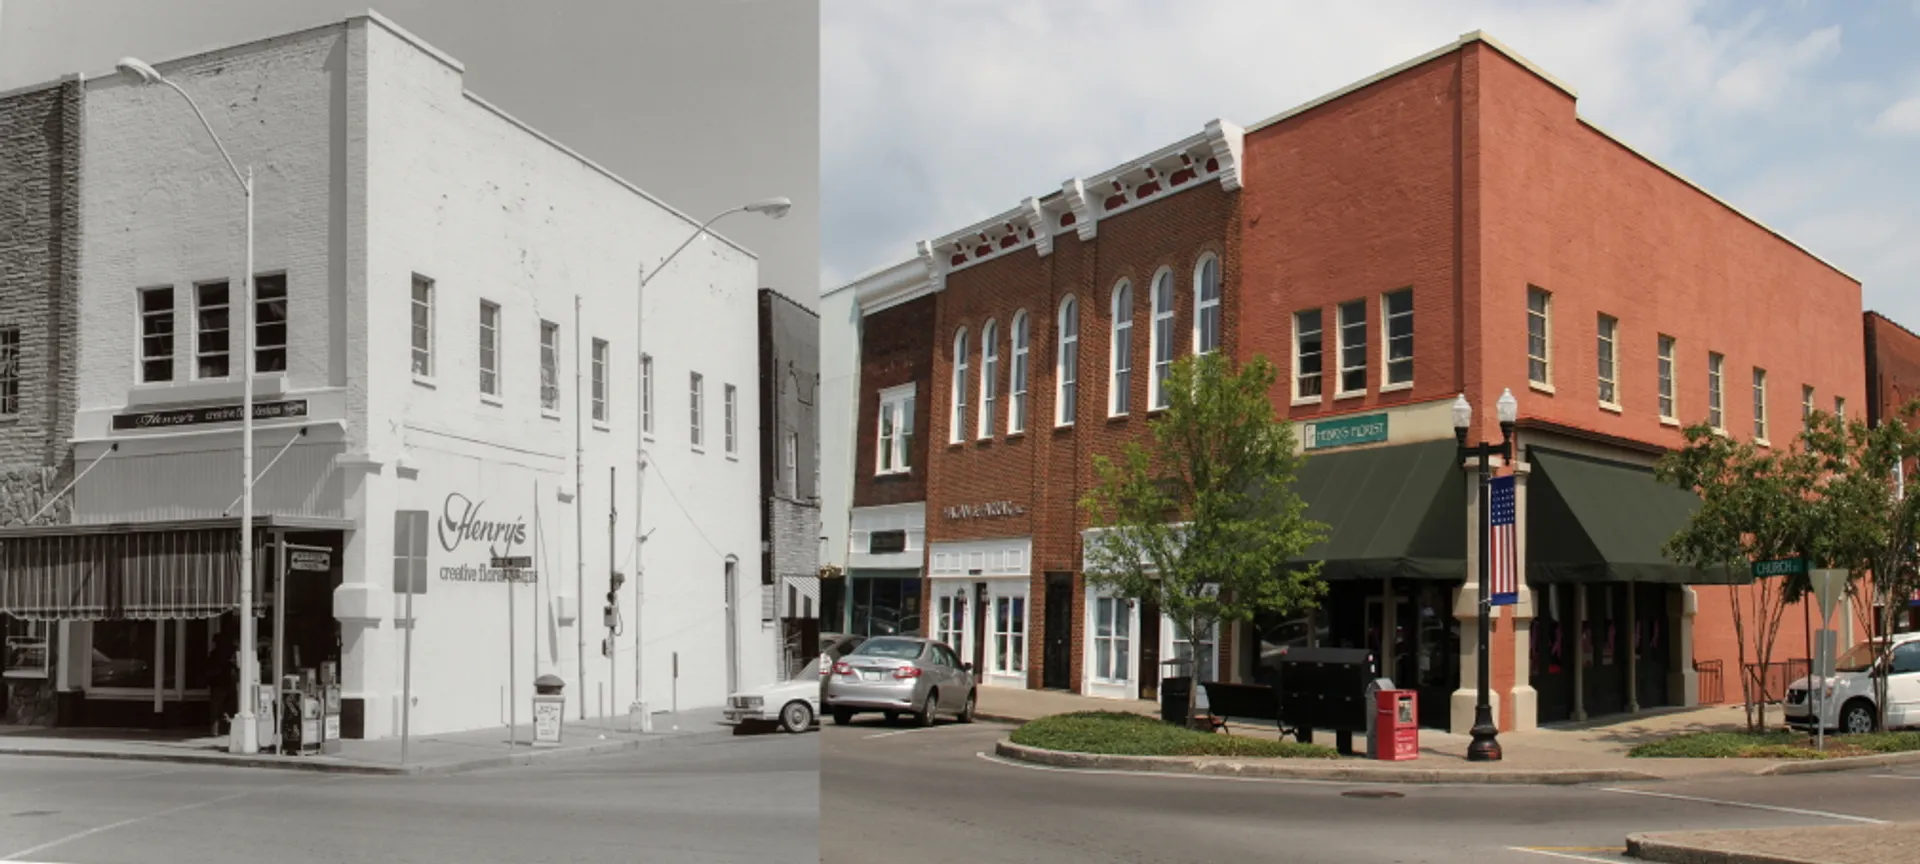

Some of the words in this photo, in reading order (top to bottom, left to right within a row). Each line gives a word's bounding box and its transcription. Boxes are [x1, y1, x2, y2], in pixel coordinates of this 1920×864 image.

[1351, 422, 1385, 437] FLORIST
[438, 492, 526, 557] Henry's
[440, 563, 478, 582] creative
[1756, 560, 1792, 576] CHURCH
